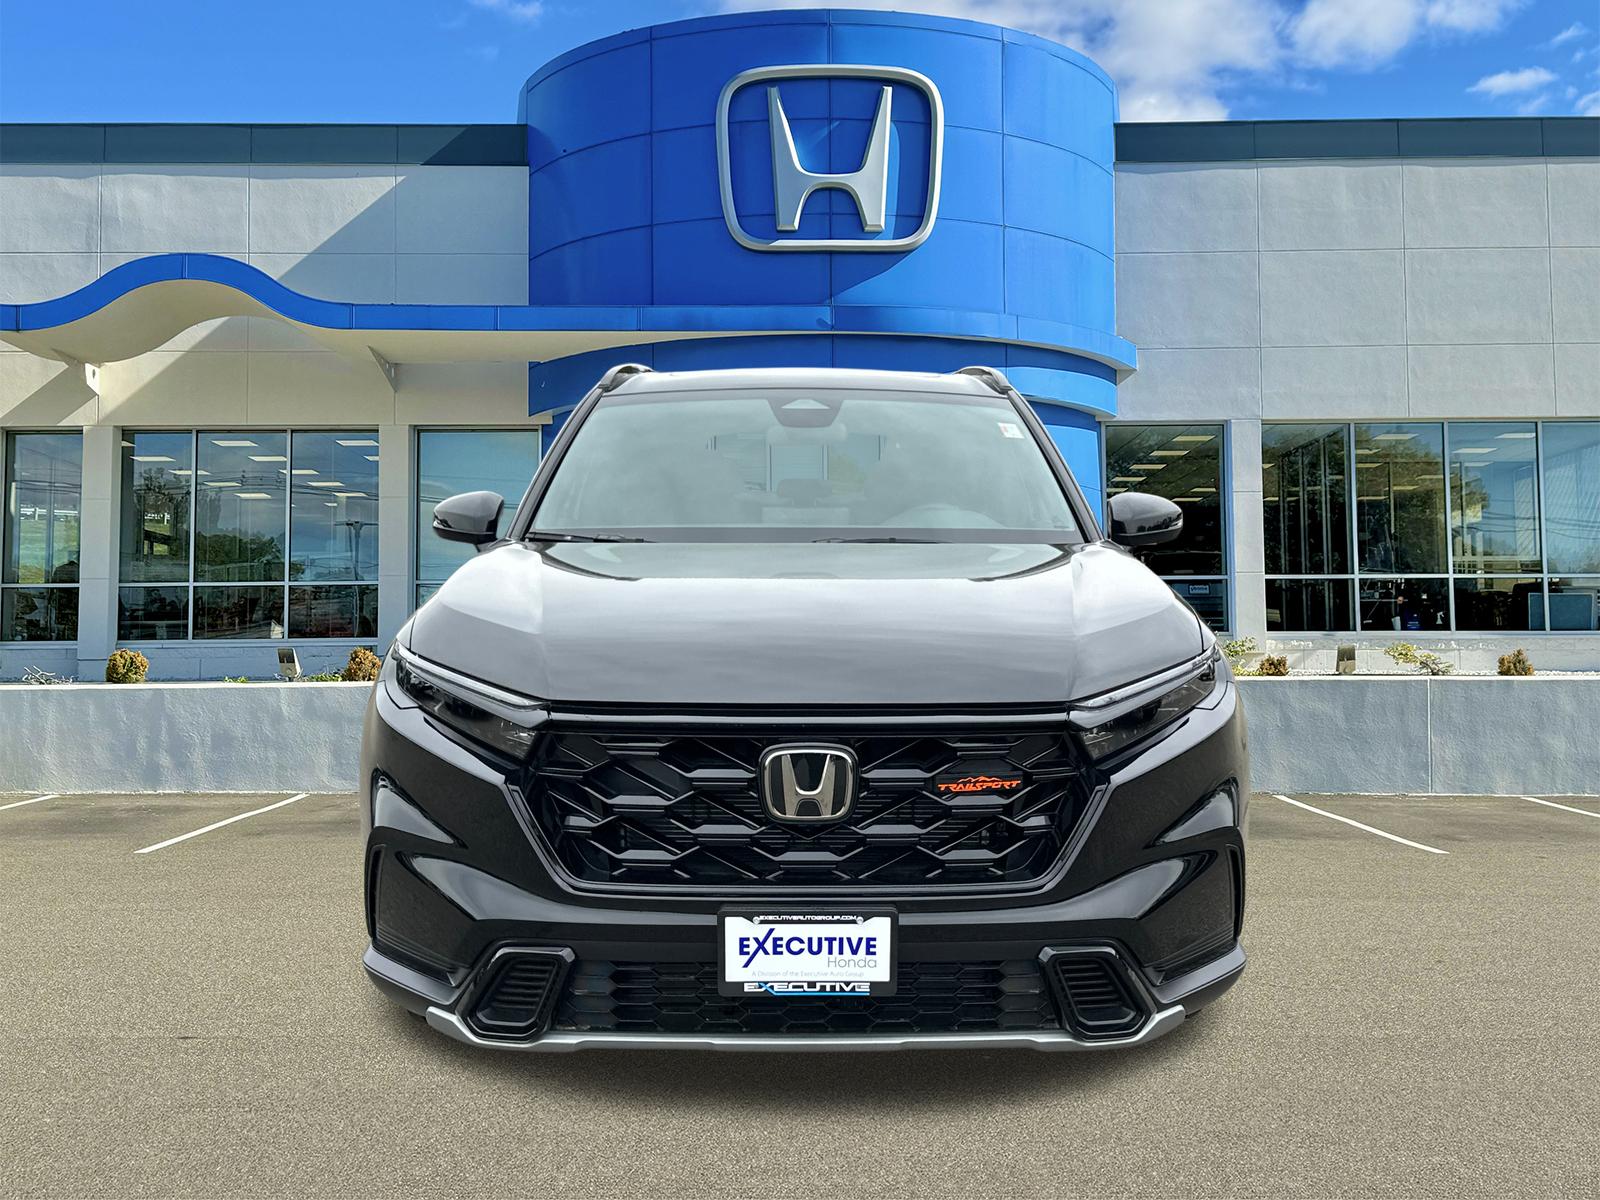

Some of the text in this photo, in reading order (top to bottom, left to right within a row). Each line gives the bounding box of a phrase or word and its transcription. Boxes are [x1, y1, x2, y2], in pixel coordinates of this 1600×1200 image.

[938, 780, 1021, 792] TRAILSPORT
[739, 928, 877, 968] EXECUTIVE
[827, 957, 877, 968] Honda
[744, 982, 870, 993] EXECUTIVE
